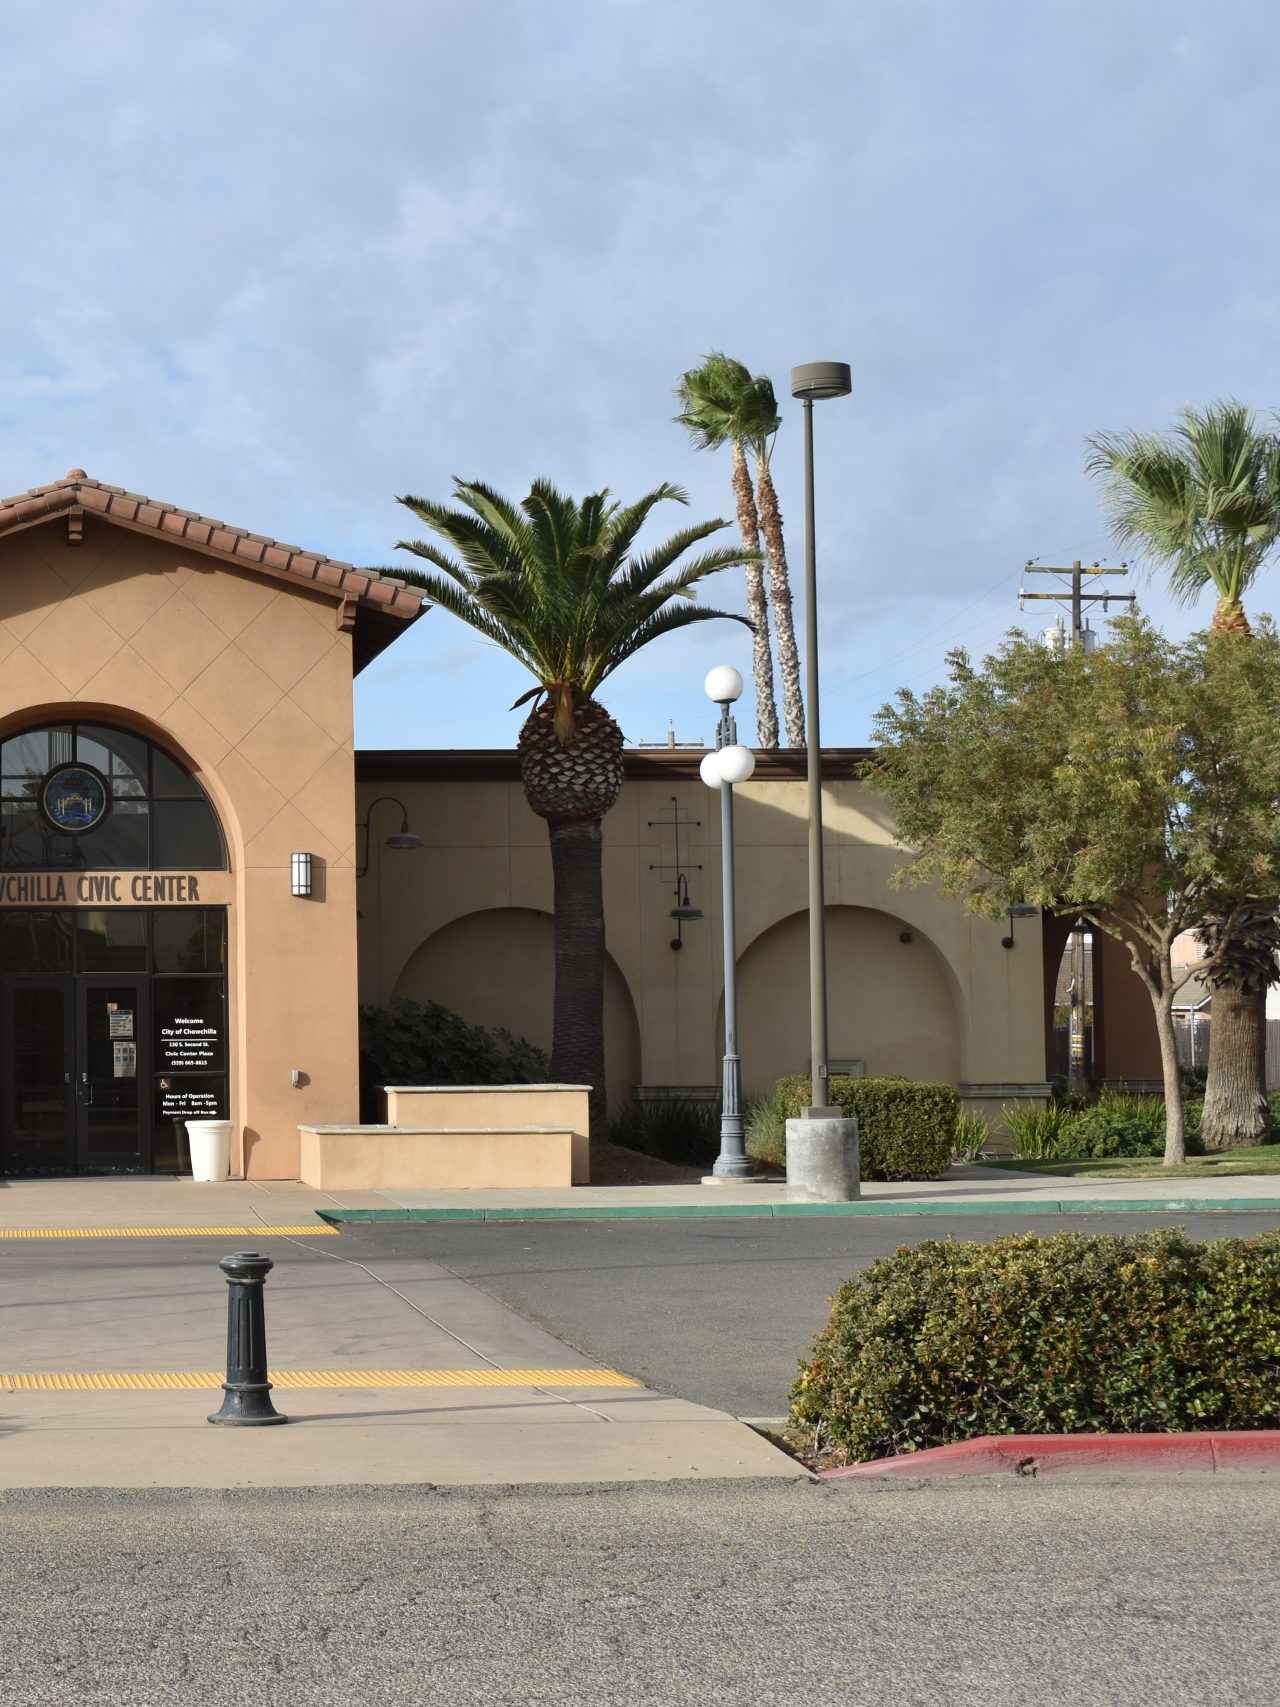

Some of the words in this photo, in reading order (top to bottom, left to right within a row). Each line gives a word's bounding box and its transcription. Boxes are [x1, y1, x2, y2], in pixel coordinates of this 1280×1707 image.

[77, 876, 121, 902] CIVIC
[131, 875, 199, 901] CENTER
[161, 1028, 174, 1036] City
